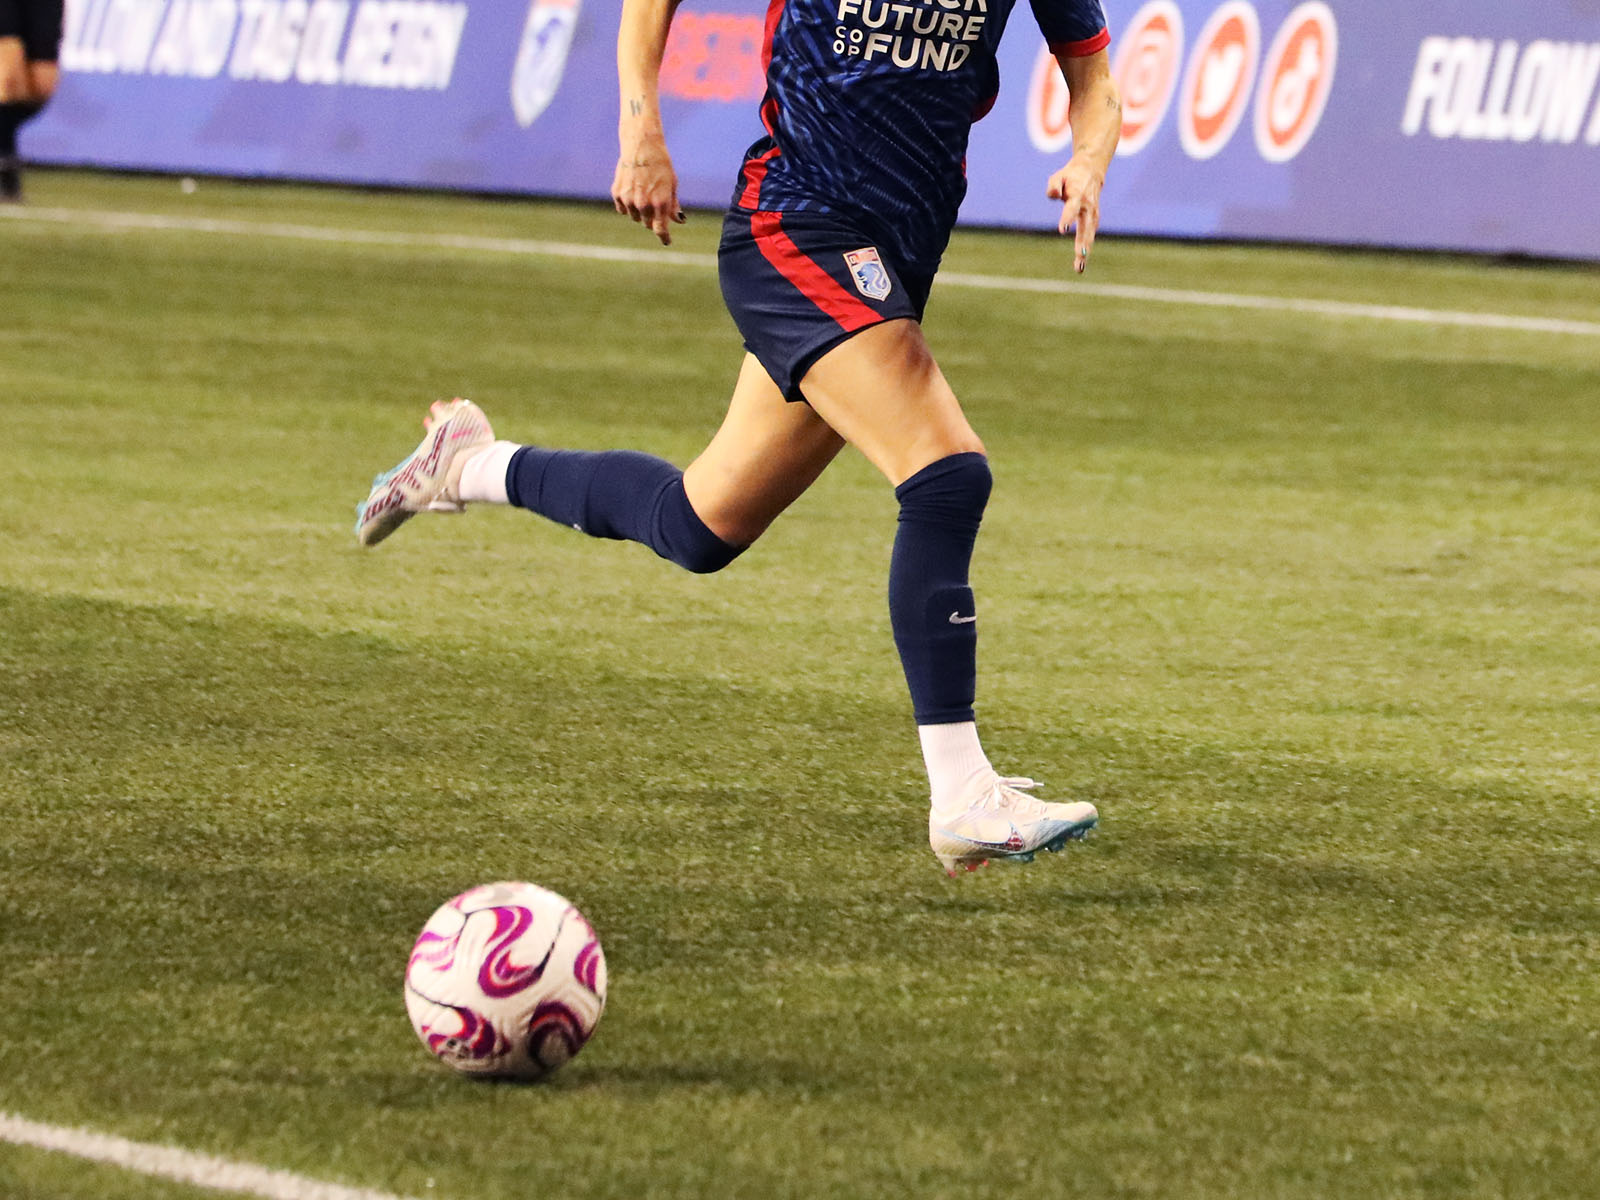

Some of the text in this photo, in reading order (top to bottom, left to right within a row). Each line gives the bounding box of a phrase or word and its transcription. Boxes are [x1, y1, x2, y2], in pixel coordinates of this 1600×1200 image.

[832, 39, 860, 57] OP
[835, 25, 864, 44] CO
[863, 32, 971, 72] FUND
[1402, 37, 1600, 143] FOLLOW
